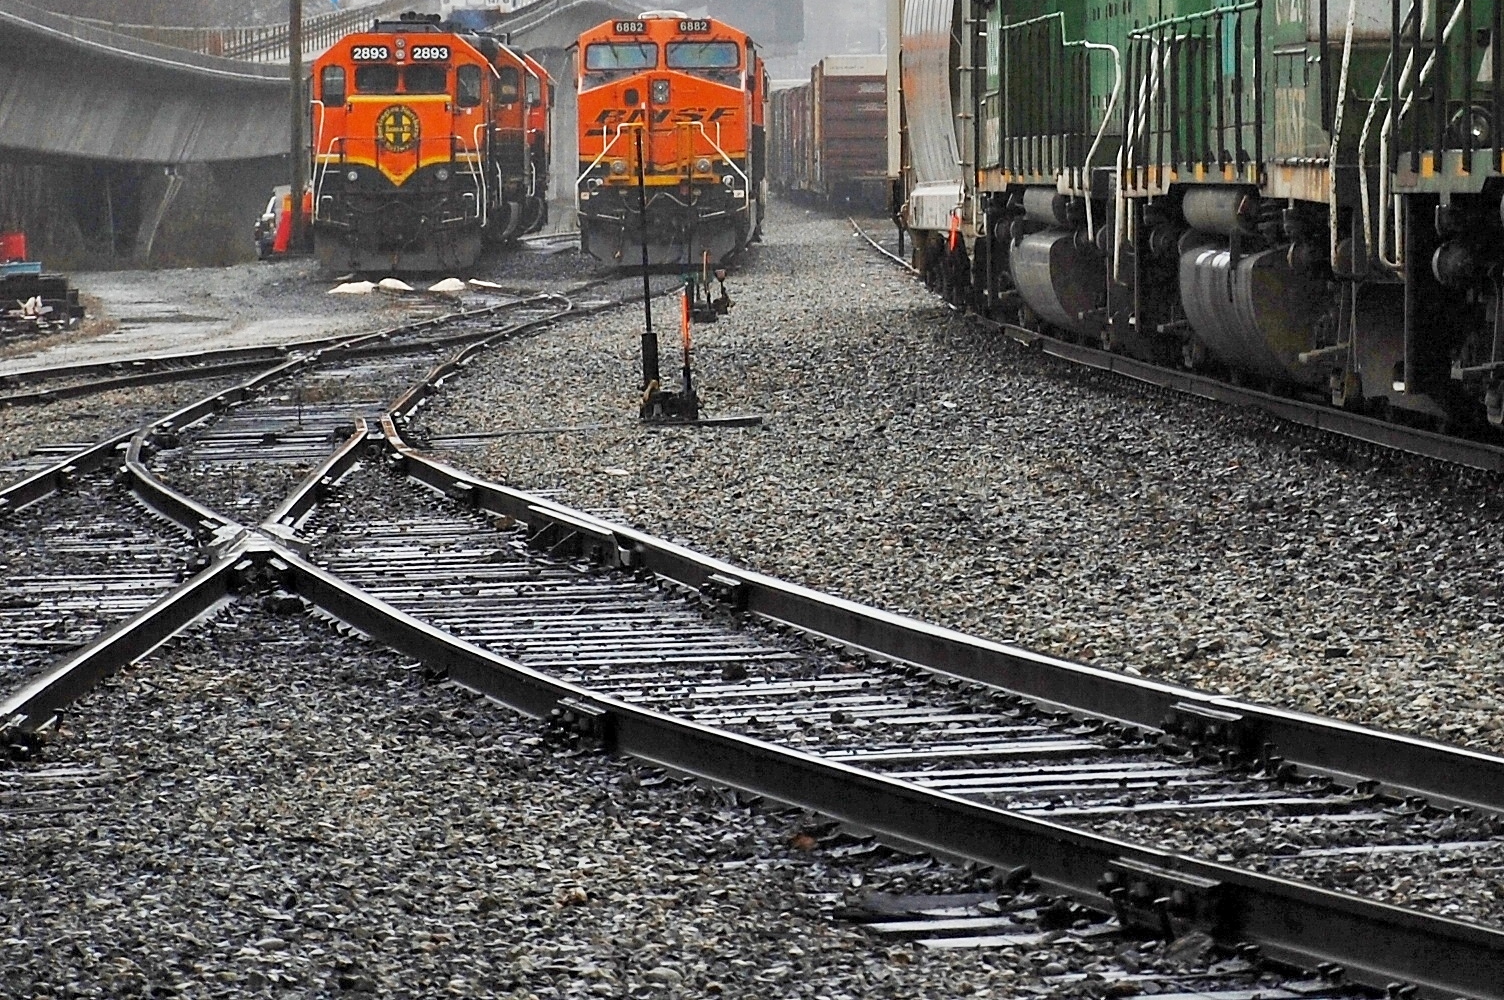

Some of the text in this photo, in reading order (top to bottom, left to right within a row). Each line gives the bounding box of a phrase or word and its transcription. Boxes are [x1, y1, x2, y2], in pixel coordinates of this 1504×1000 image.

[615, 21, 645, 33] 6882
[679, 20, 708, 32] 6882
[353, 47, 388, 60] 2893
[412, 47, 449, 59] 2893
[593, 106, 740, 124] BNSF
